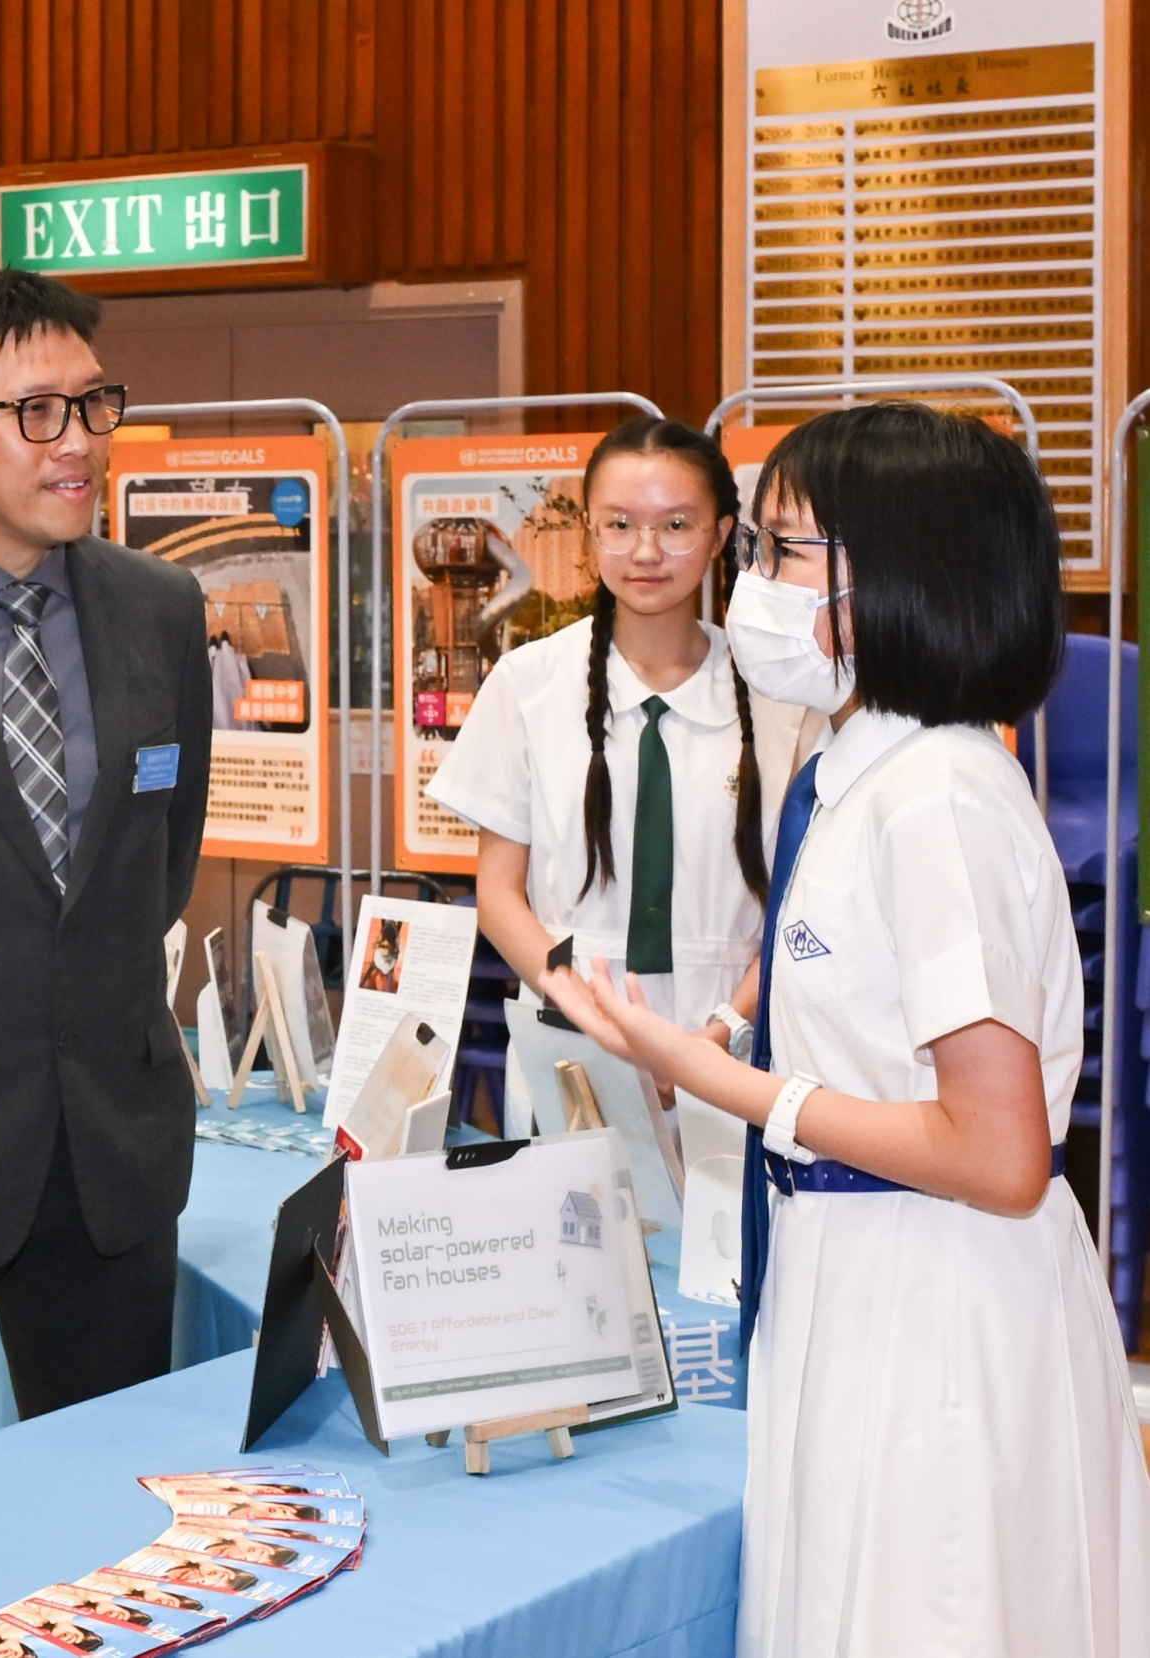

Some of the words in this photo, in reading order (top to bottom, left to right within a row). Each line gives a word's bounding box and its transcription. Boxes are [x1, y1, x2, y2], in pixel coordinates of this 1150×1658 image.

[887, 21, 918, 41] QUEEN
[920, 15, 952, 39] MAUD
[814, 69, 866, 84] Former
[873, 63, 916, 80] Heads
[976, 53, 1031, 71] Houses
[21, 193, 163, 261] EXIT
[184, 187, 281, 251] 出口
[220, 448, 266, 466] GOALS
[525, 444, 579, 464] GOALS
[422, 498, 493, 515] 共融遊樂場
[376, 1213, 454, 1238] Making
[379, 1228, 536, 1265] solar-powered
[383, 1268, 420, 1292] fan
[425, 1264, 502, 1288] houses
[421, 1321, 427, 1334] 7
[431, 1313, 501, 1331] Affordable
[503, 1309, 525, 1322] and
[527, 1306, 560, 1321] Clean
[390, 1337, 440, 1354] Energy
[662, 1318, 737, 1403] 基
